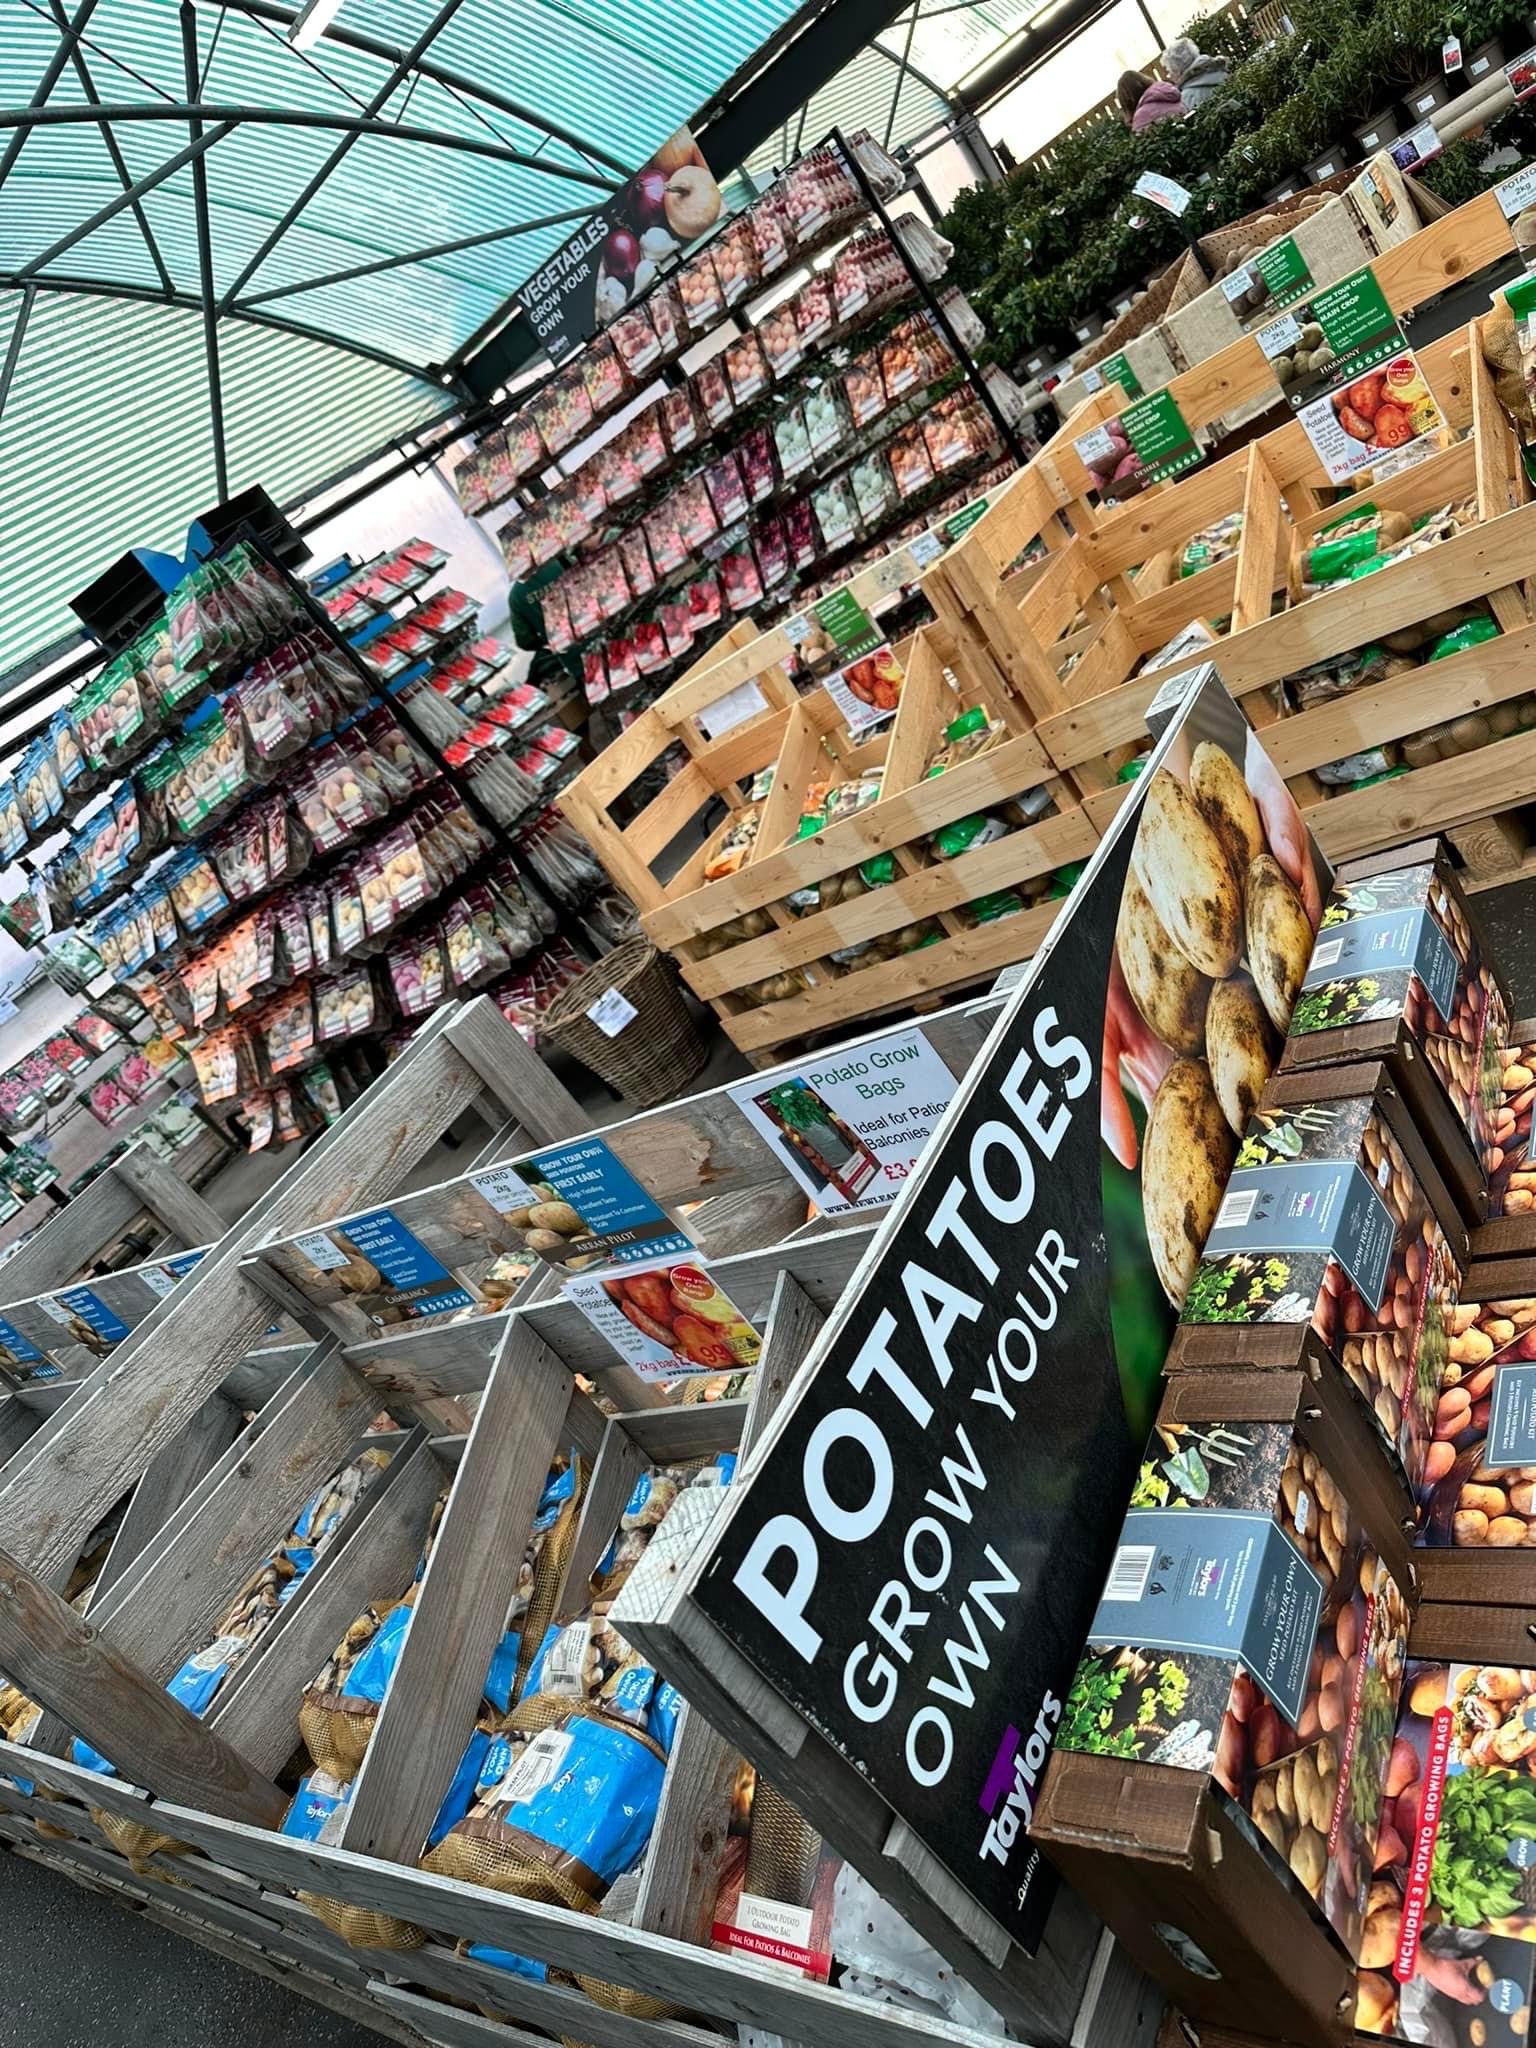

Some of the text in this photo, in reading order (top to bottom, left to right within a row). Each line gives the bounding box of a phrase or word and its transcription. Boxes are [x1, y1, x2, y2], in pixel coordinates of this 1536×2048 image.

[1514, 182, 1532, 196] 2kg
[518, 216, 609, 308] VEGETABLES
[530, 263, 592, 324] GROW YOUR
[1314, 273, 1367, 310] GROW YOUR OWN
[1320, 294, 1359, 322] MAIN CROP
[537, 309, 564, 337] OWN
[1260, 317, 1288, 336] POTATO
[1321, 347, 1359, 373] HARMONY
[1306, 404, 1327, 418] Seed
[1306, 413, 1332, 429] Potatoe
[1332, 463, 1349, 474] 2kg
[809, 1044, 920, 1090] Potato Grow
[856, 1075, 905, 1100] Bags
[853, 1117, 887, 1134] Ideal
[888, 1111, 908, 1126] for
[864, 1125, 931, 1151] Balconies
[538, 1145, 603, 1171] GROW YOUR OWN
[476, 1171, 508, 1186] POTATO
[493, 1183, 511, 1194] 2kg
[553, 1169, 605, 1189] FIRST EARLY
[298, 1234, 323, 1247] POTATO
[344, 1226, 363, 1236] GROW
[361, 1221, 378, 1230] YOUR
[575, 1231, 637, 1251] ARRAN PILOT
[1352, 1243, 1364, 1276] GROW
[1360, 1218, 1371, 1245] YOUR
[1367, 1193, 1377, 1218] OWN
[359, 1234, 397, 1251] FIRST EARLY
[385, 1285, 429, 1303] CASABLANCA
[572, 1285, 599, 1298] Seed
[577, 1297, 614, 1311] Potatoe
[732, 1005, 1093, 1664] POTATOES
[635, 1360, 659, 1373] 2kg
[659, 1358, 680, 1370] bag
[842, 1228, 1080, 1725] GROW YOUR
[1194, 1558, 1217, 1597] Taylors
[1265, 1636, 1282, 1681] GROW
[1275, 1592, 1291, 1635] YOUR
[1286, 1556, 1297, 1591] OWN
[1279, 1641, 1288, 1662] SEED
[1284, 1603, 1296, 1640] POTATO
[904, 1543, 1022, 1787] OWN
[619, 1672, 637, 1696] OWN
[627, 1678, 646, 1700] YOUR
[1329, 1777, 1348, 1850] INCLUDES
[1346, 1706, 1359, 1761] POTATO
[1354, 1641, 1369, 1702] GROWING
[1366, 1601, 1375, 1639] BAGS
[487, 1746, 500, 1776] YOUR
[495, 1747, 509, 1776] OWN
[979, 1689, 1061, 1867] Taylors
[305, 1804, 332, 1819] Taylor
[1398, 1715, 1450, 1975] INCLUDES 3 POTATO GROWING BAGS
[1518, 1837, 1529, 1868] GROW
[750, 1906, 778, 1923] OUTDOOR
[778, 1912, 800, 1928] POTATO
[752, 1918, 791, 1938] GROWING BAG
[729, 1931, 743, 1945] IDEAL
[743, 1935, 755, 1948] FOR
[755, 1937, 775, 1954] PATIOS
[781, 1945, 811, 1965] BALCONIES
[1500, 1979, 1513, 2014] PLANT
